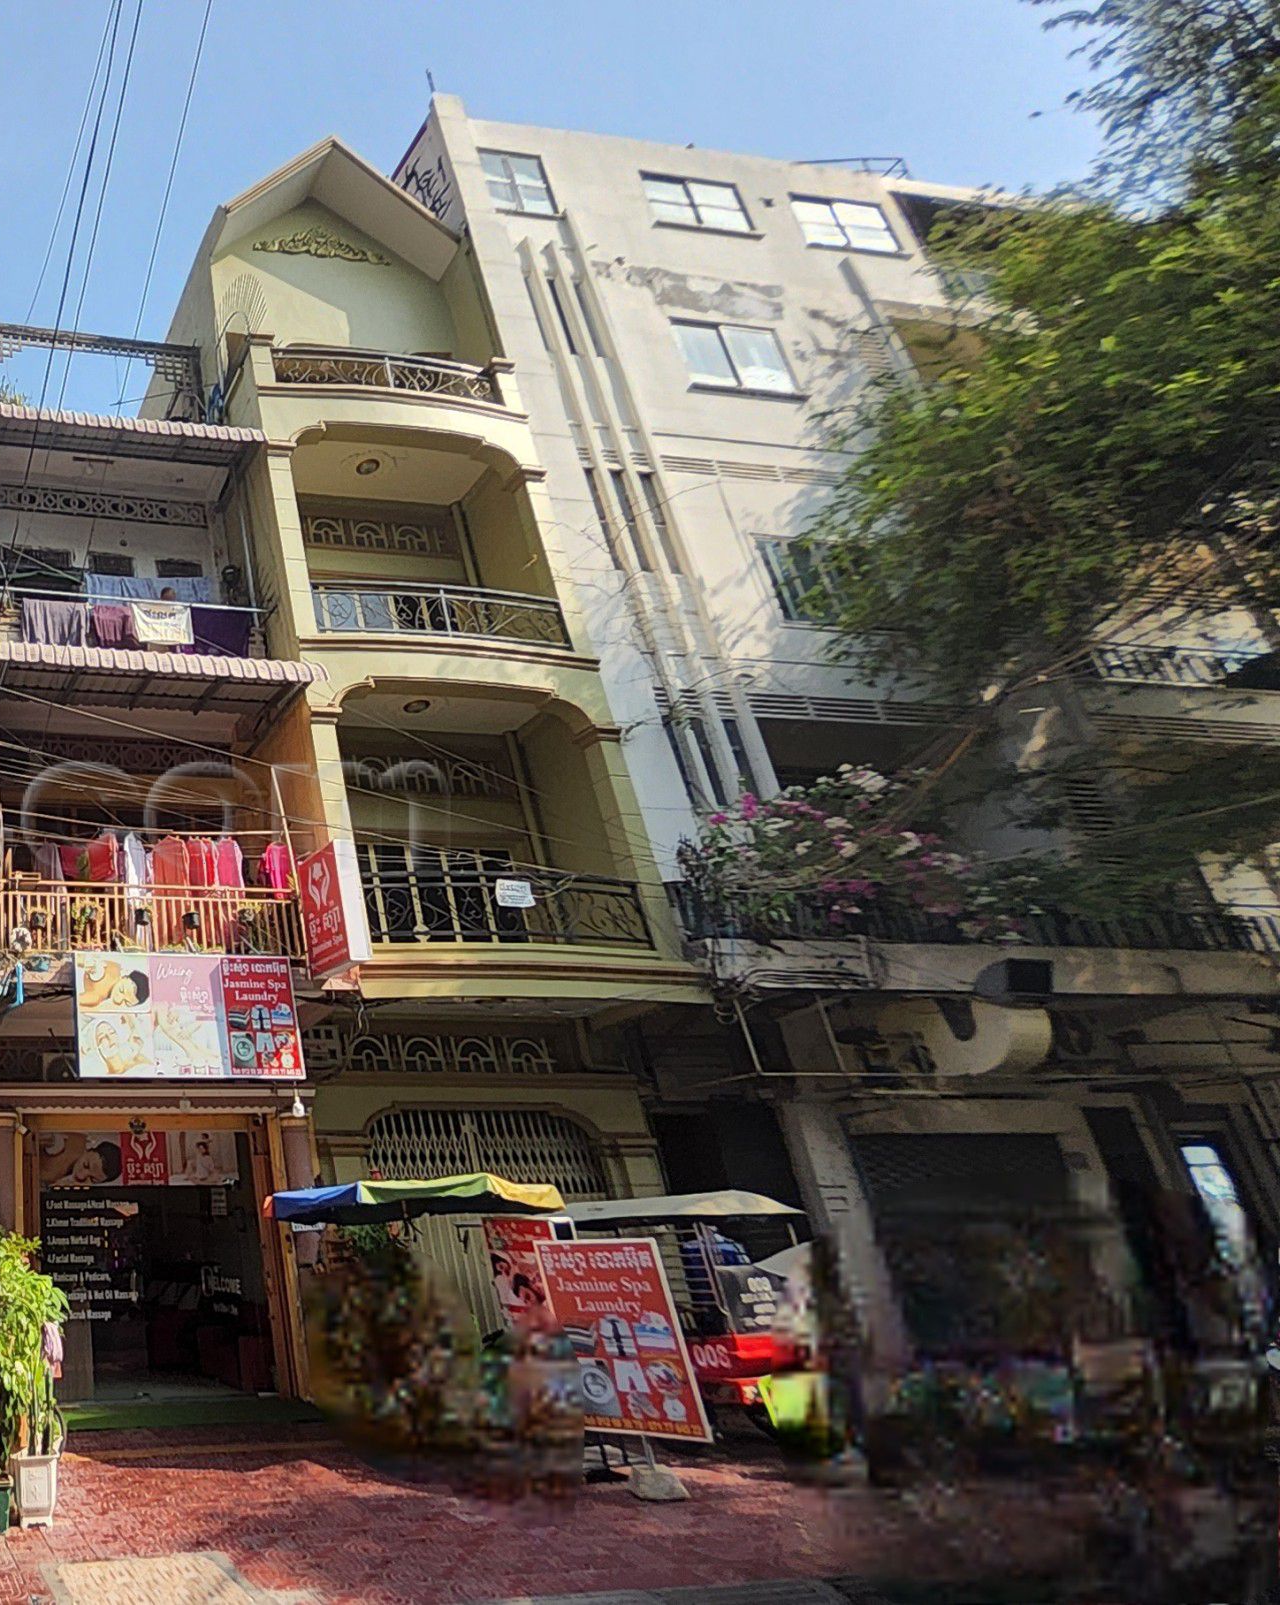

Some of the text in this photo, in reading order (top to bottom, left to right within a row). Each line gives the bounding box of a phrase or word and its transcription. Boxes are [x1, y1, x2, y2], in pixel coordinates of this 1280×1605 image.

[223, 979, 287, 992] Jasmine Spa
[235, 990, 278, 1004] Laundry
[556, 1276, 652, 1297] Jasmine Spa
[575, 1297, 641, 1317] Laundry
